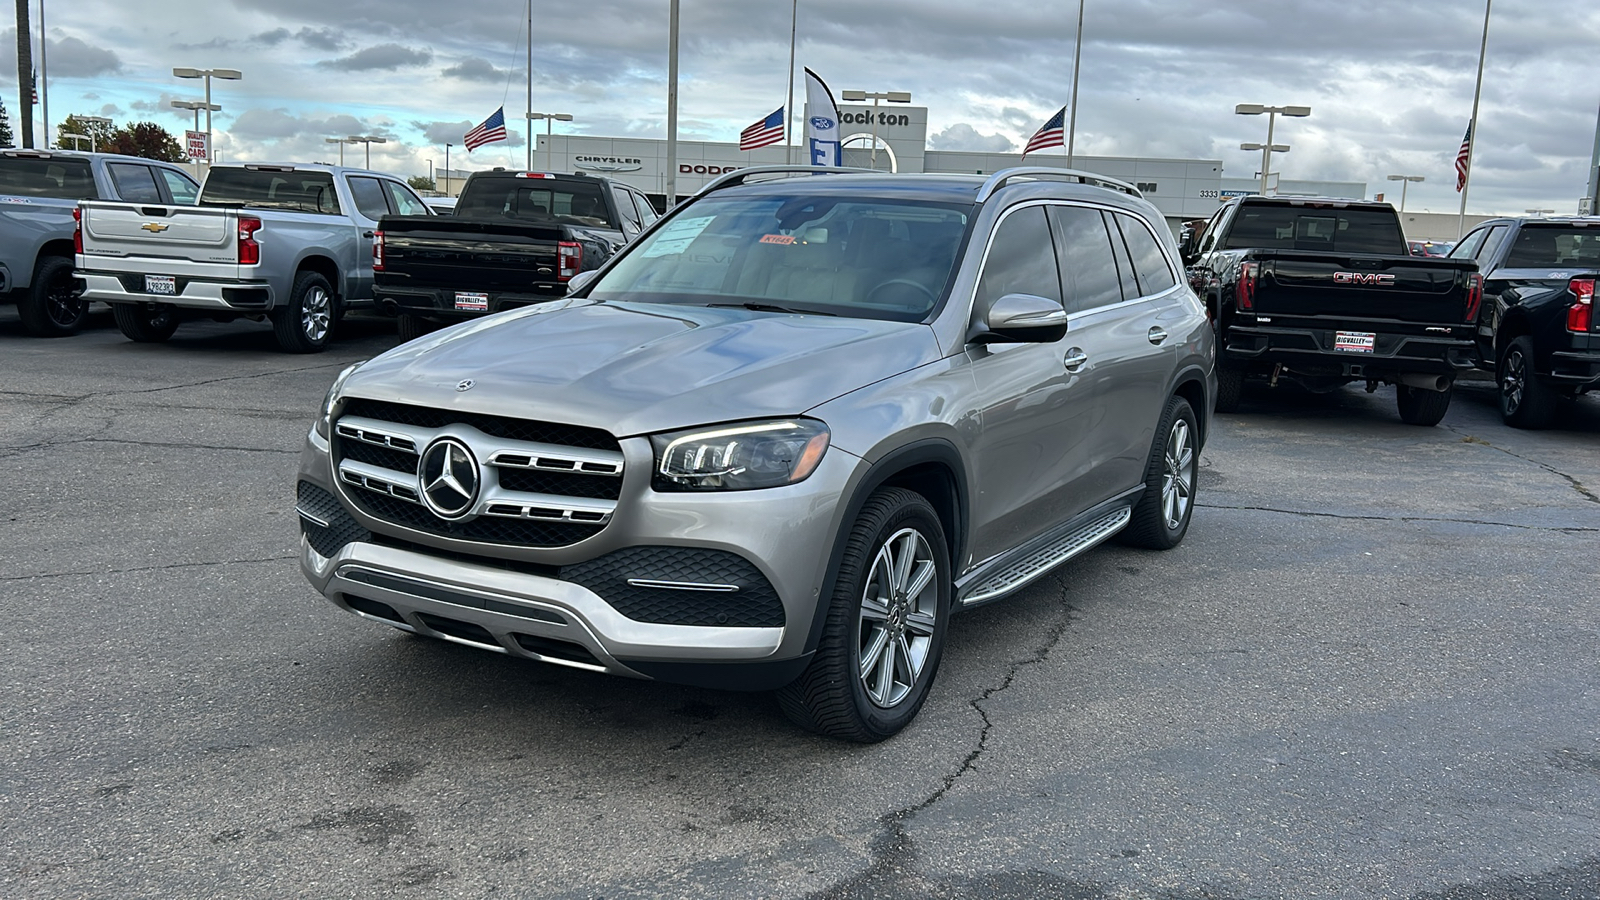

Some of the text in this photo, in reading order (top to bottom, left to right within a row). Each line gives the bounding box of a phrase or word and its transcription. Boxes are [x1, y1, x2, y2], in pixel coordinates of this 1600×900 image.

[838, 110, 909, 126] tockton
[187, 132, 206, 141] QUALITY
[189, 140, 205, 149] USED
[187, 147, 207, 158] CARS
[575, 155, 642, 165] CHRYSLER
[679, 164, 744, 175] DODG
[1199, 190, 1218, 198] 3333
[410, 251, 529, 263] PLATINUM
[1333, 271, 1396, 286] GMC
